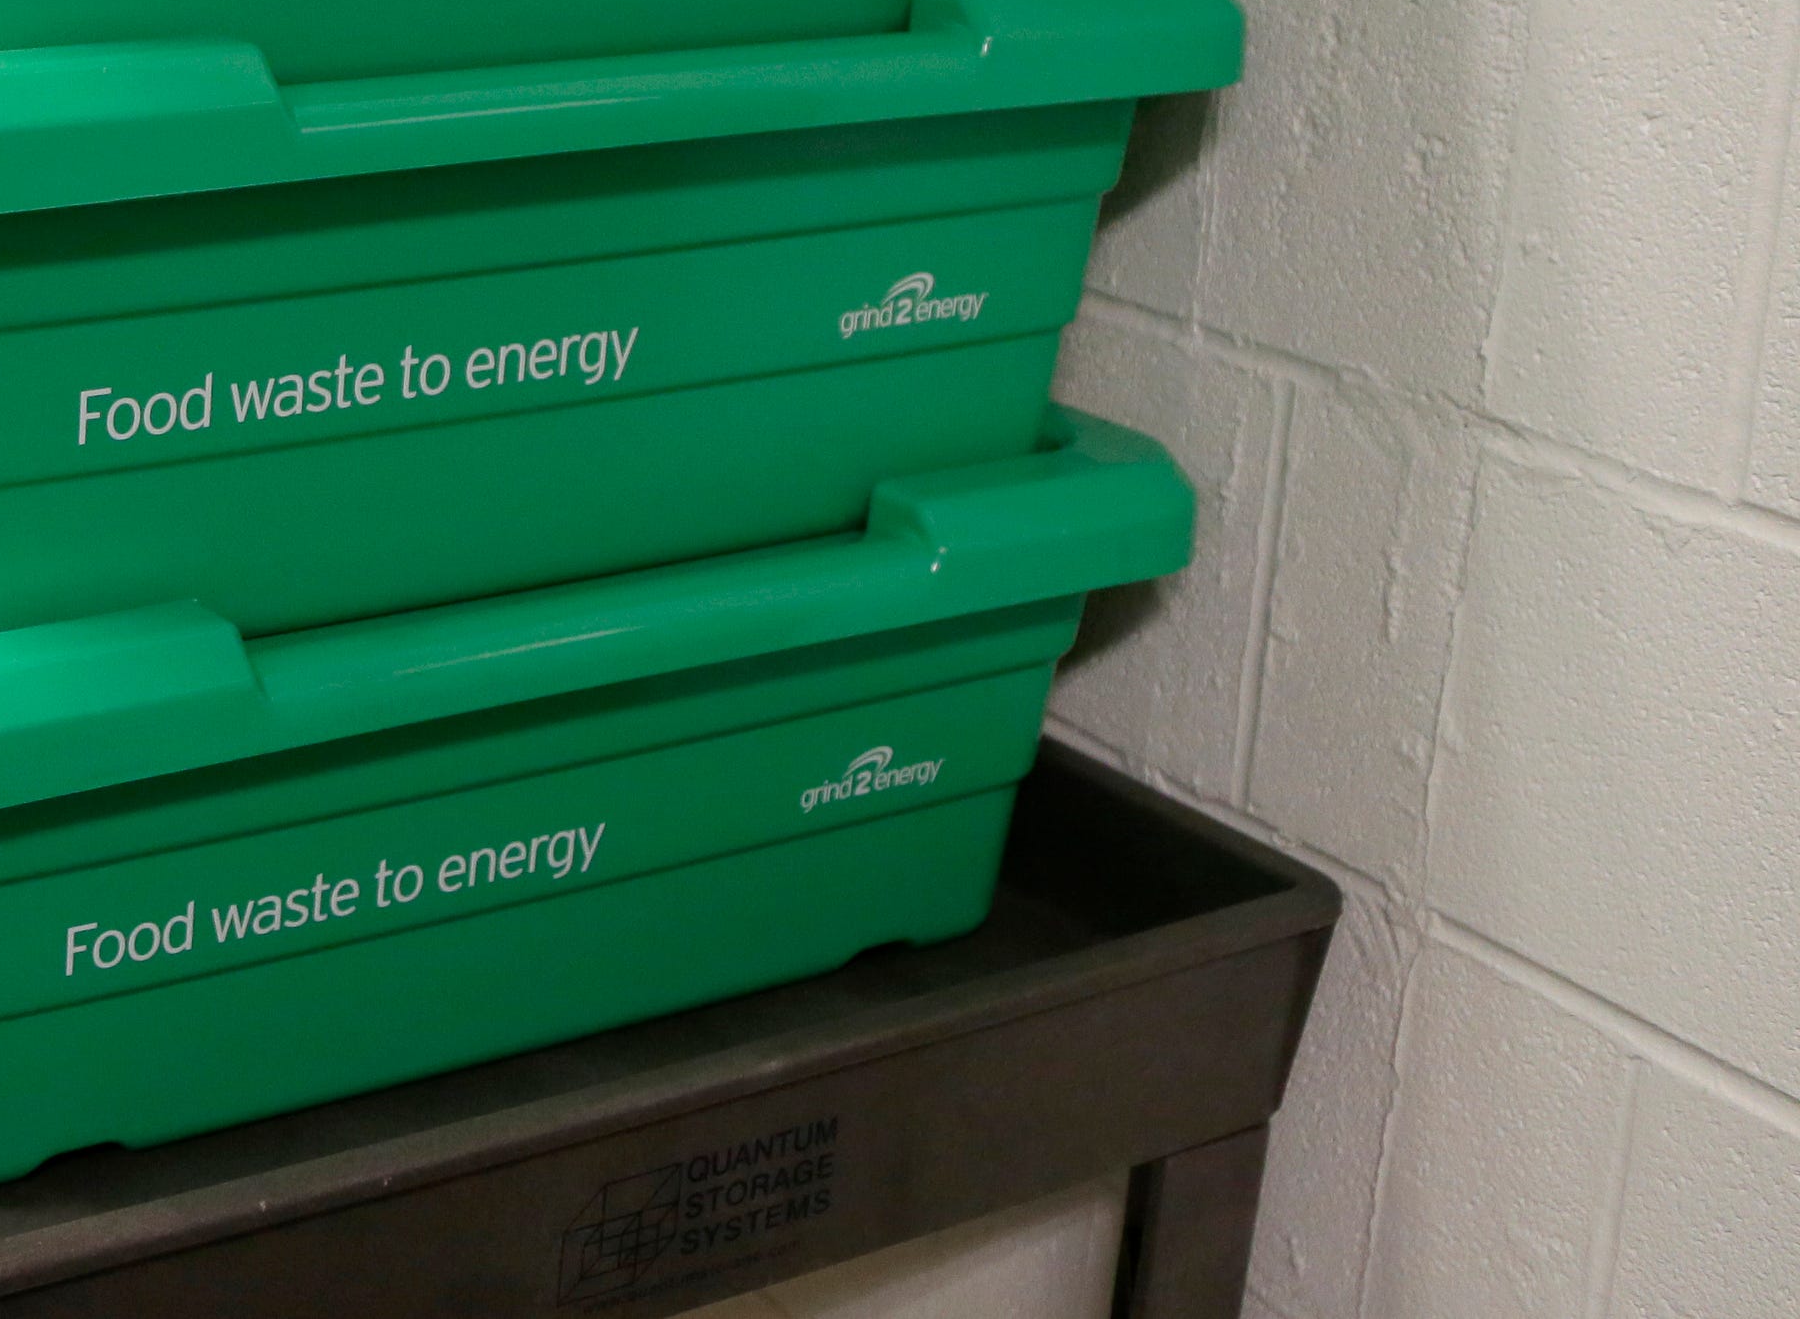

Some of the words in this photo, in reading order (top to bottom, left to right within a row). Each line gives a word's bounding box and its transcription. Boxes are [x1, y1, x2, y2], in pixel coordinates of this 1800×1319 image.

[78, 371, 213, 446] Food
[230, 353, 385, 423] waste
[400, 345, 451, 400] to
[465, 326, 640, 390] energy
[64, 899, 196, 977] Food
[210, 872, 360, 943] waste
[375, 858, 424, 909] to
[438, 822, 607, 893] energy
[687, 1115, 839, 1183] QUANTUM
[684, 1152, 836, 1220] STORAGE
[679, 1188, 832, 1255] SYSTEMS
